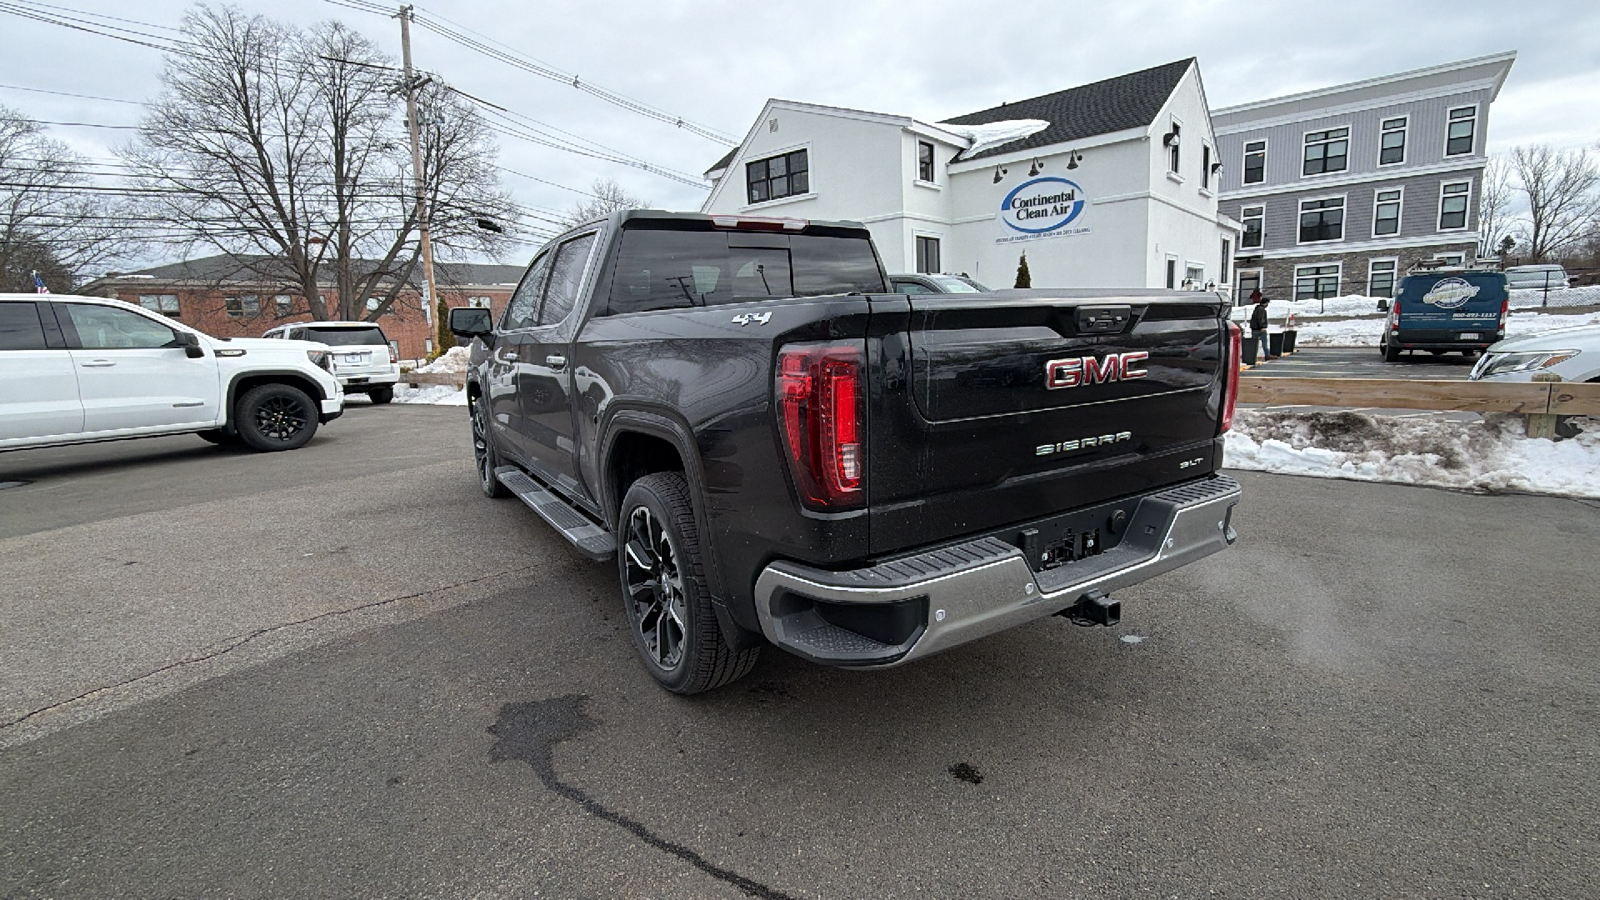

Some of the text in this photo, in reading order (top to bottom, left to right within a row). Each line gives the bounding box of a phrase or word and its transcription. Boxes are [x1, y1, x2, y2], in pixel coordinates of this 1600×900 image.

[1011, 188, 1075, 209] Continental
[1016, 203, 1070, 220] Clean Air
[1046, 351, 1148, 390] GMC
[1036, 431, 1132, 455] SIERRA
[1179, 457, 1203, 469] SLT
